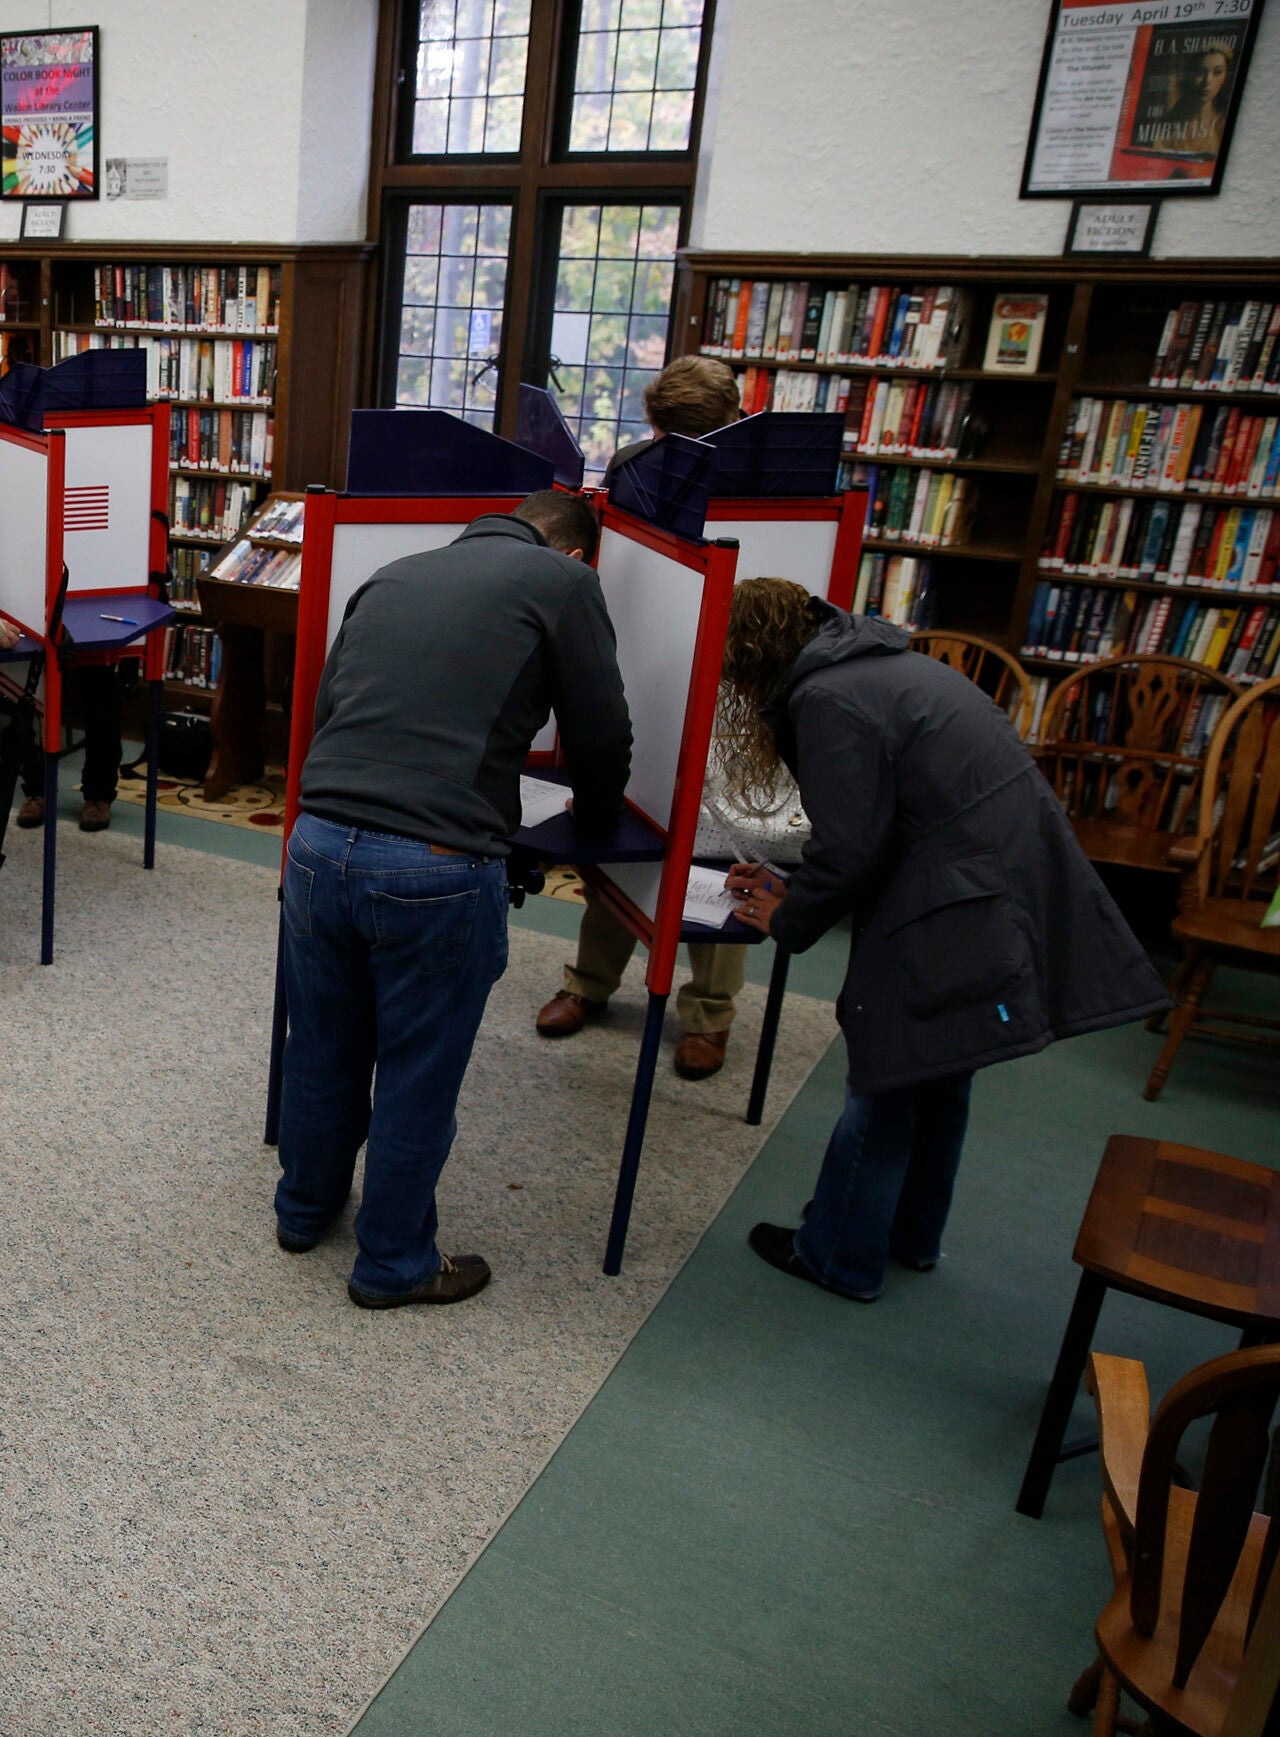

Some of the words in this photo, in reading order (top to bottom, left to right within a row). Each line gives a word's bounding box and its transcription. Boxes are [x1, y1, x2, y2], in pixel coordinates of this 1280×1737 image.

[1061, 11, 1124, 28] Tuesday
[1131, 7, 1170, 24] April
[1173, 3, 1206, 19] 19th
[1214, 0, 1250, 14] 7:30
[1182, 34, 1238, 54] SHAPIRO
[3, 70, 33, 82] COLOR
[35, 69, 61, 80] BOOK
[63, 67, 91, 79] NIGHT
[34, 86, 43, 96] at
[45, 85, 60, 95] the
[34, 101, 63, 113] Library
[63, 100, 91, 111] Center
[1135, 119, 1218, 144] MURALIST
[21, 150, 73, 161] WEDNESDAY
[39, 164, 56, 174] 7:30
[1093, 215, 1136, 224] ADULT
[1086, 227, 1136, 236] FICTION
